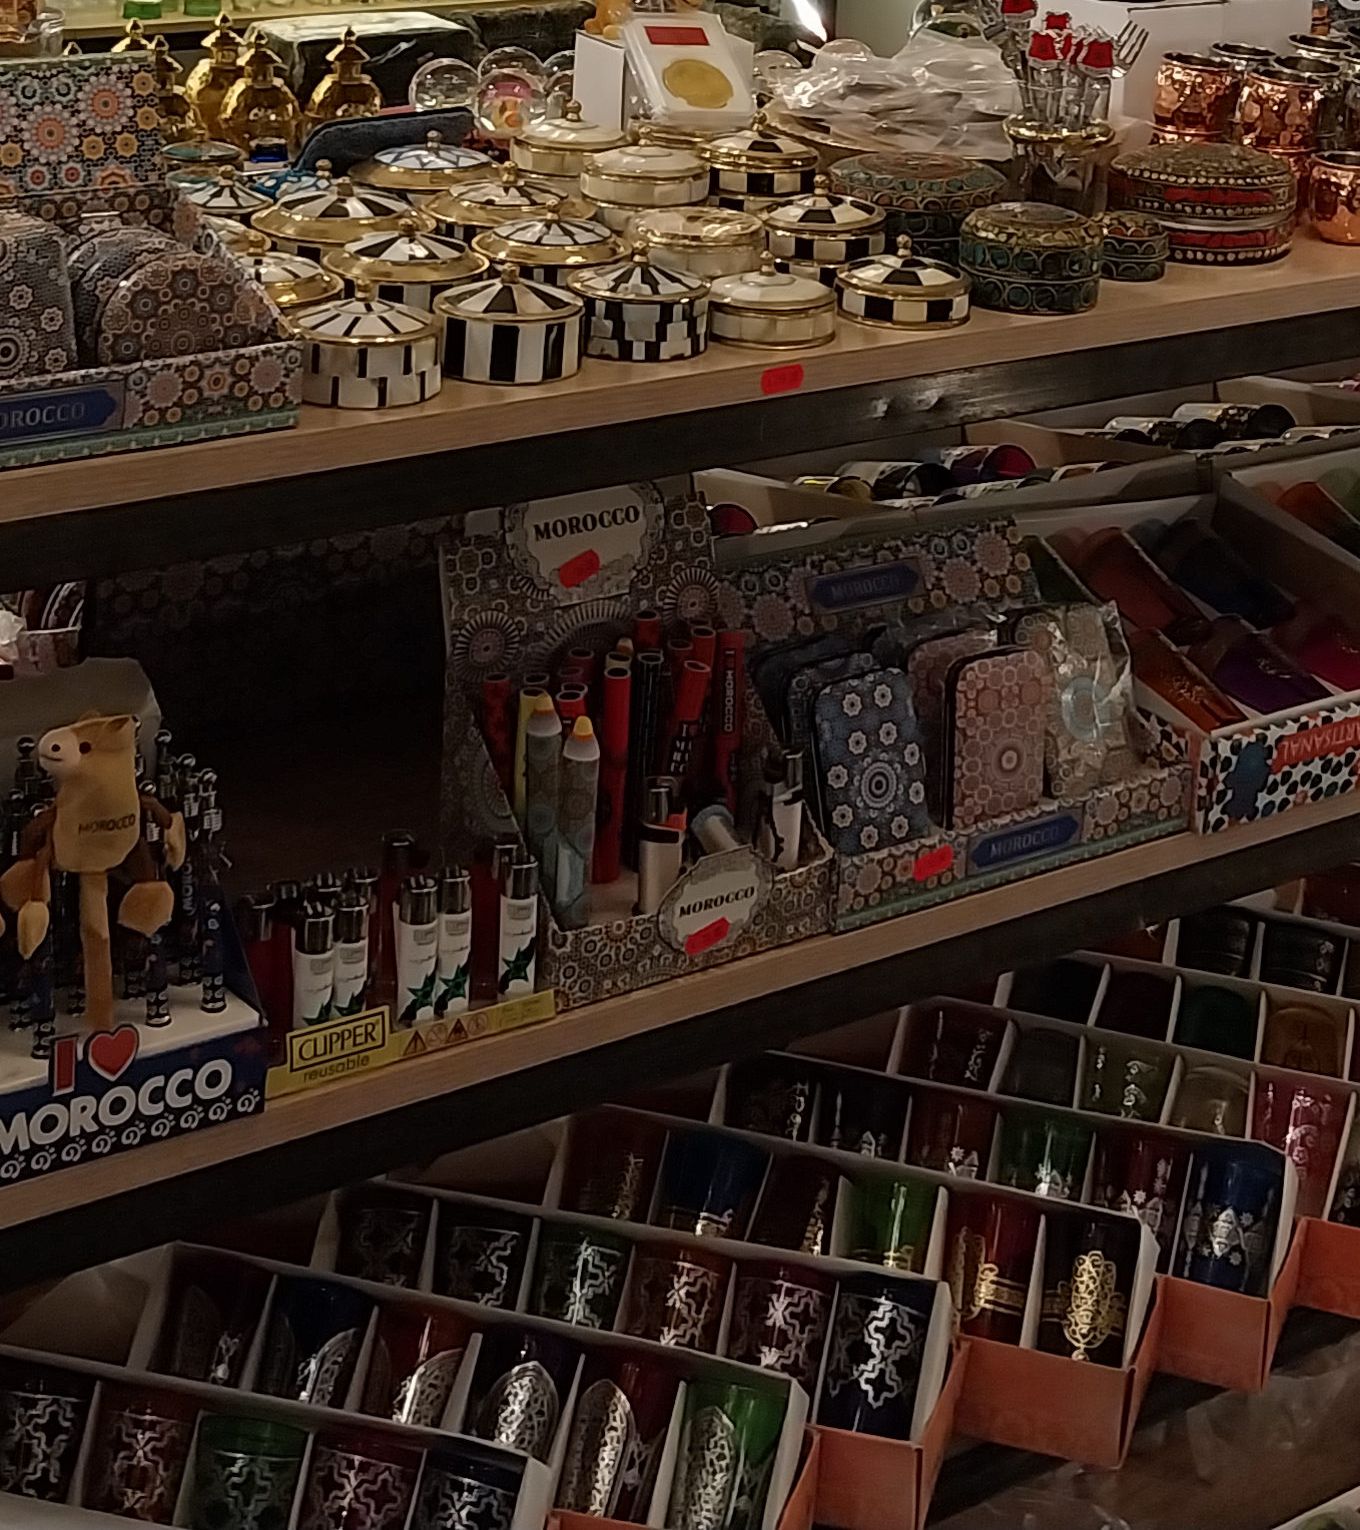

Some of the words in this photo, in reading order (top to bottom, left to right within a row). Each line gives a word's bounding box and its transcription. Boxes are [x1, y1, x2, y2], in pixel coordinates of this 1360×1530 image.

[533, 505, 640, 542] MOROCCO
[830, 574, 900, 601] MOROCCO
[724, 670, 735, 733] MOROCCO
[78, 814, 136, 834] MOROCCO
[990, 826, 1059, 859] MOROCCO
[680, 886, 755, 918] MOROCCO
[299, 1022, 377, 1062] CLIPPER
[52, 1035, 78, 1097] I
[303, 1054, 370, 1082] reusable
